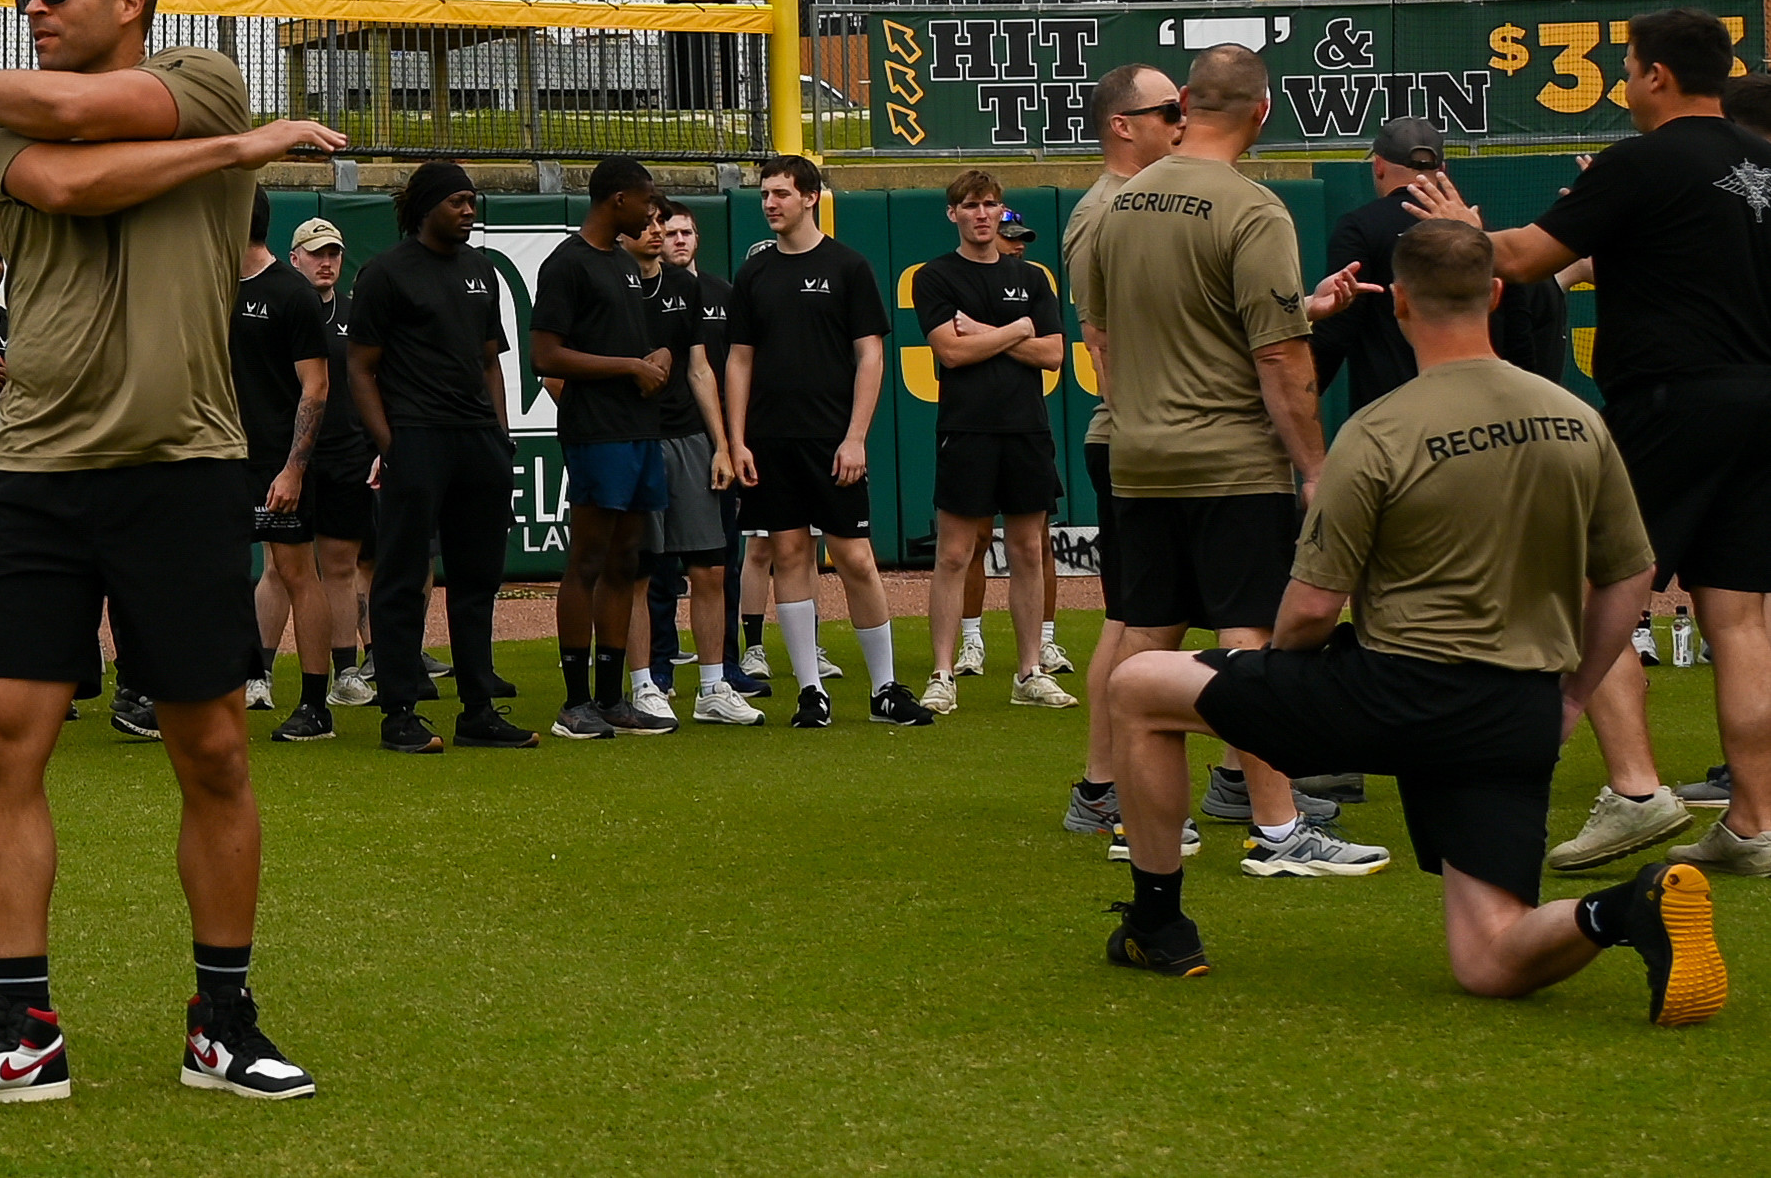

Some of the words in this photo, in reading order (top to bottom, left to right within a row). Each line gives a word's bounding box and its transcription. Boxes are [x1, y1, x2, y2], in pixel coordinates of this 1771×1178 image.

[928, 19, 1098, 81] HIT
[1313, 17, 1374, 70] &
[1487, 15, 1748, 114] $3
[977, 82, 1101, 144] TH
[1281, 70, 1491, 137] WIN
[1110, 192, 1213, 221] RECRUITER
[1424, 416, 1589, 462] RECRUITER
[523, 525, 571, 552] LA
